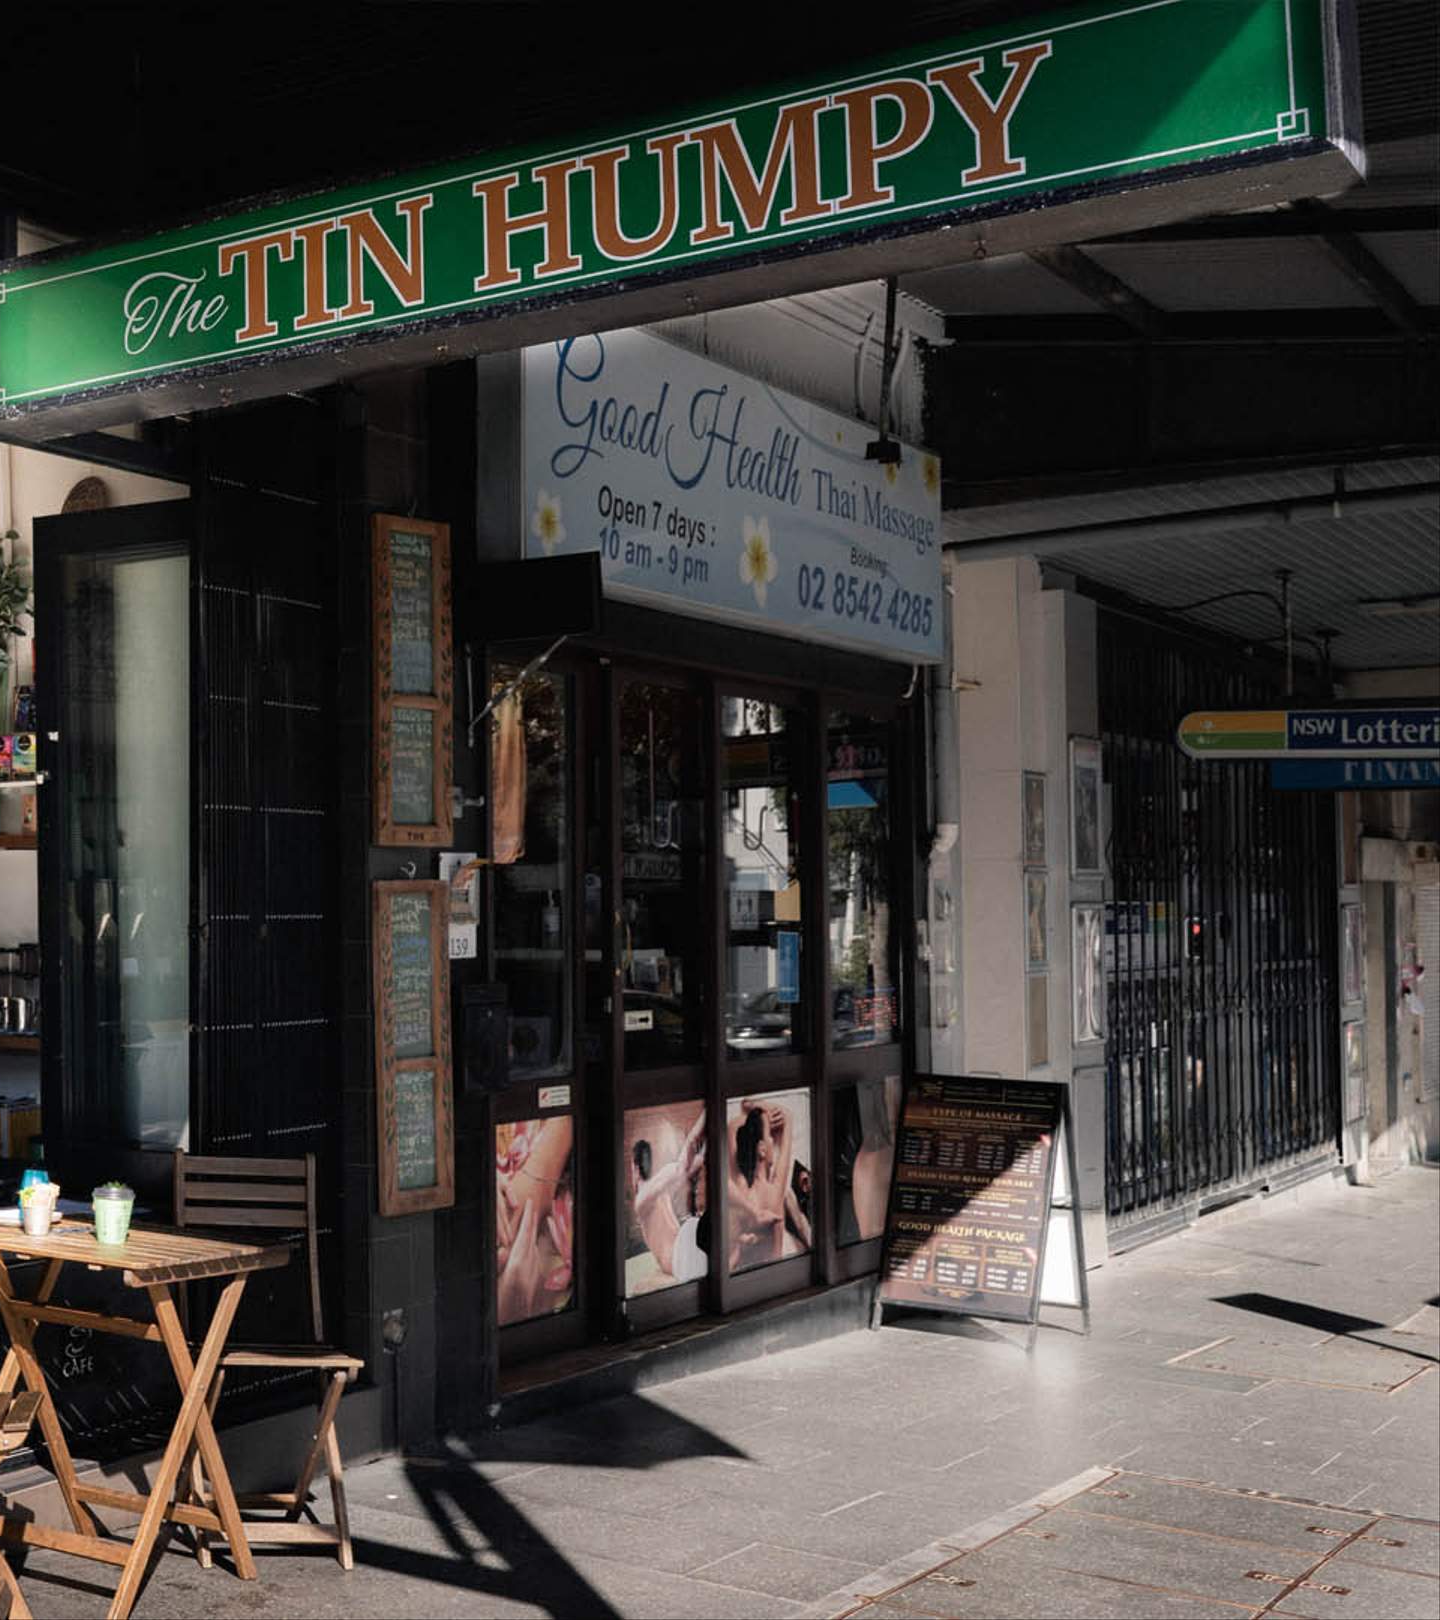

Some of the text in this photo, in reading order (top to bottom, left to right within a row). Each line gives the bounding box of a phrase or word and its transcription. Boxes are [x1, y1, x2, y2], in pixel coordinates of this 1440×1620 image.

[123, 40, 1054, 357] The TIN HUMPY
[550, 332, 936, 556] Good Health Thai Massage
[597, 485, 647, 533] Open
[651, 501, 662, 530] 7
[667, 505, 707, 550] days
[599, 527, 621, 561] 10
[624, 537, 653, 570] am
[667, 543, 679, 574] 9
[682, 556, 709, 585] pm
[797, 562, 934, 637] 02 8542 4285
[1292, 717, 1440, 745] NSW Lotteri
[450, 938, 469, 957] 139
[897, 1221, 931, 1233] GOOD
[975, 1226, 1026, 1243] PACKAGE
[62, 1356, 95, 1378] CAFE
